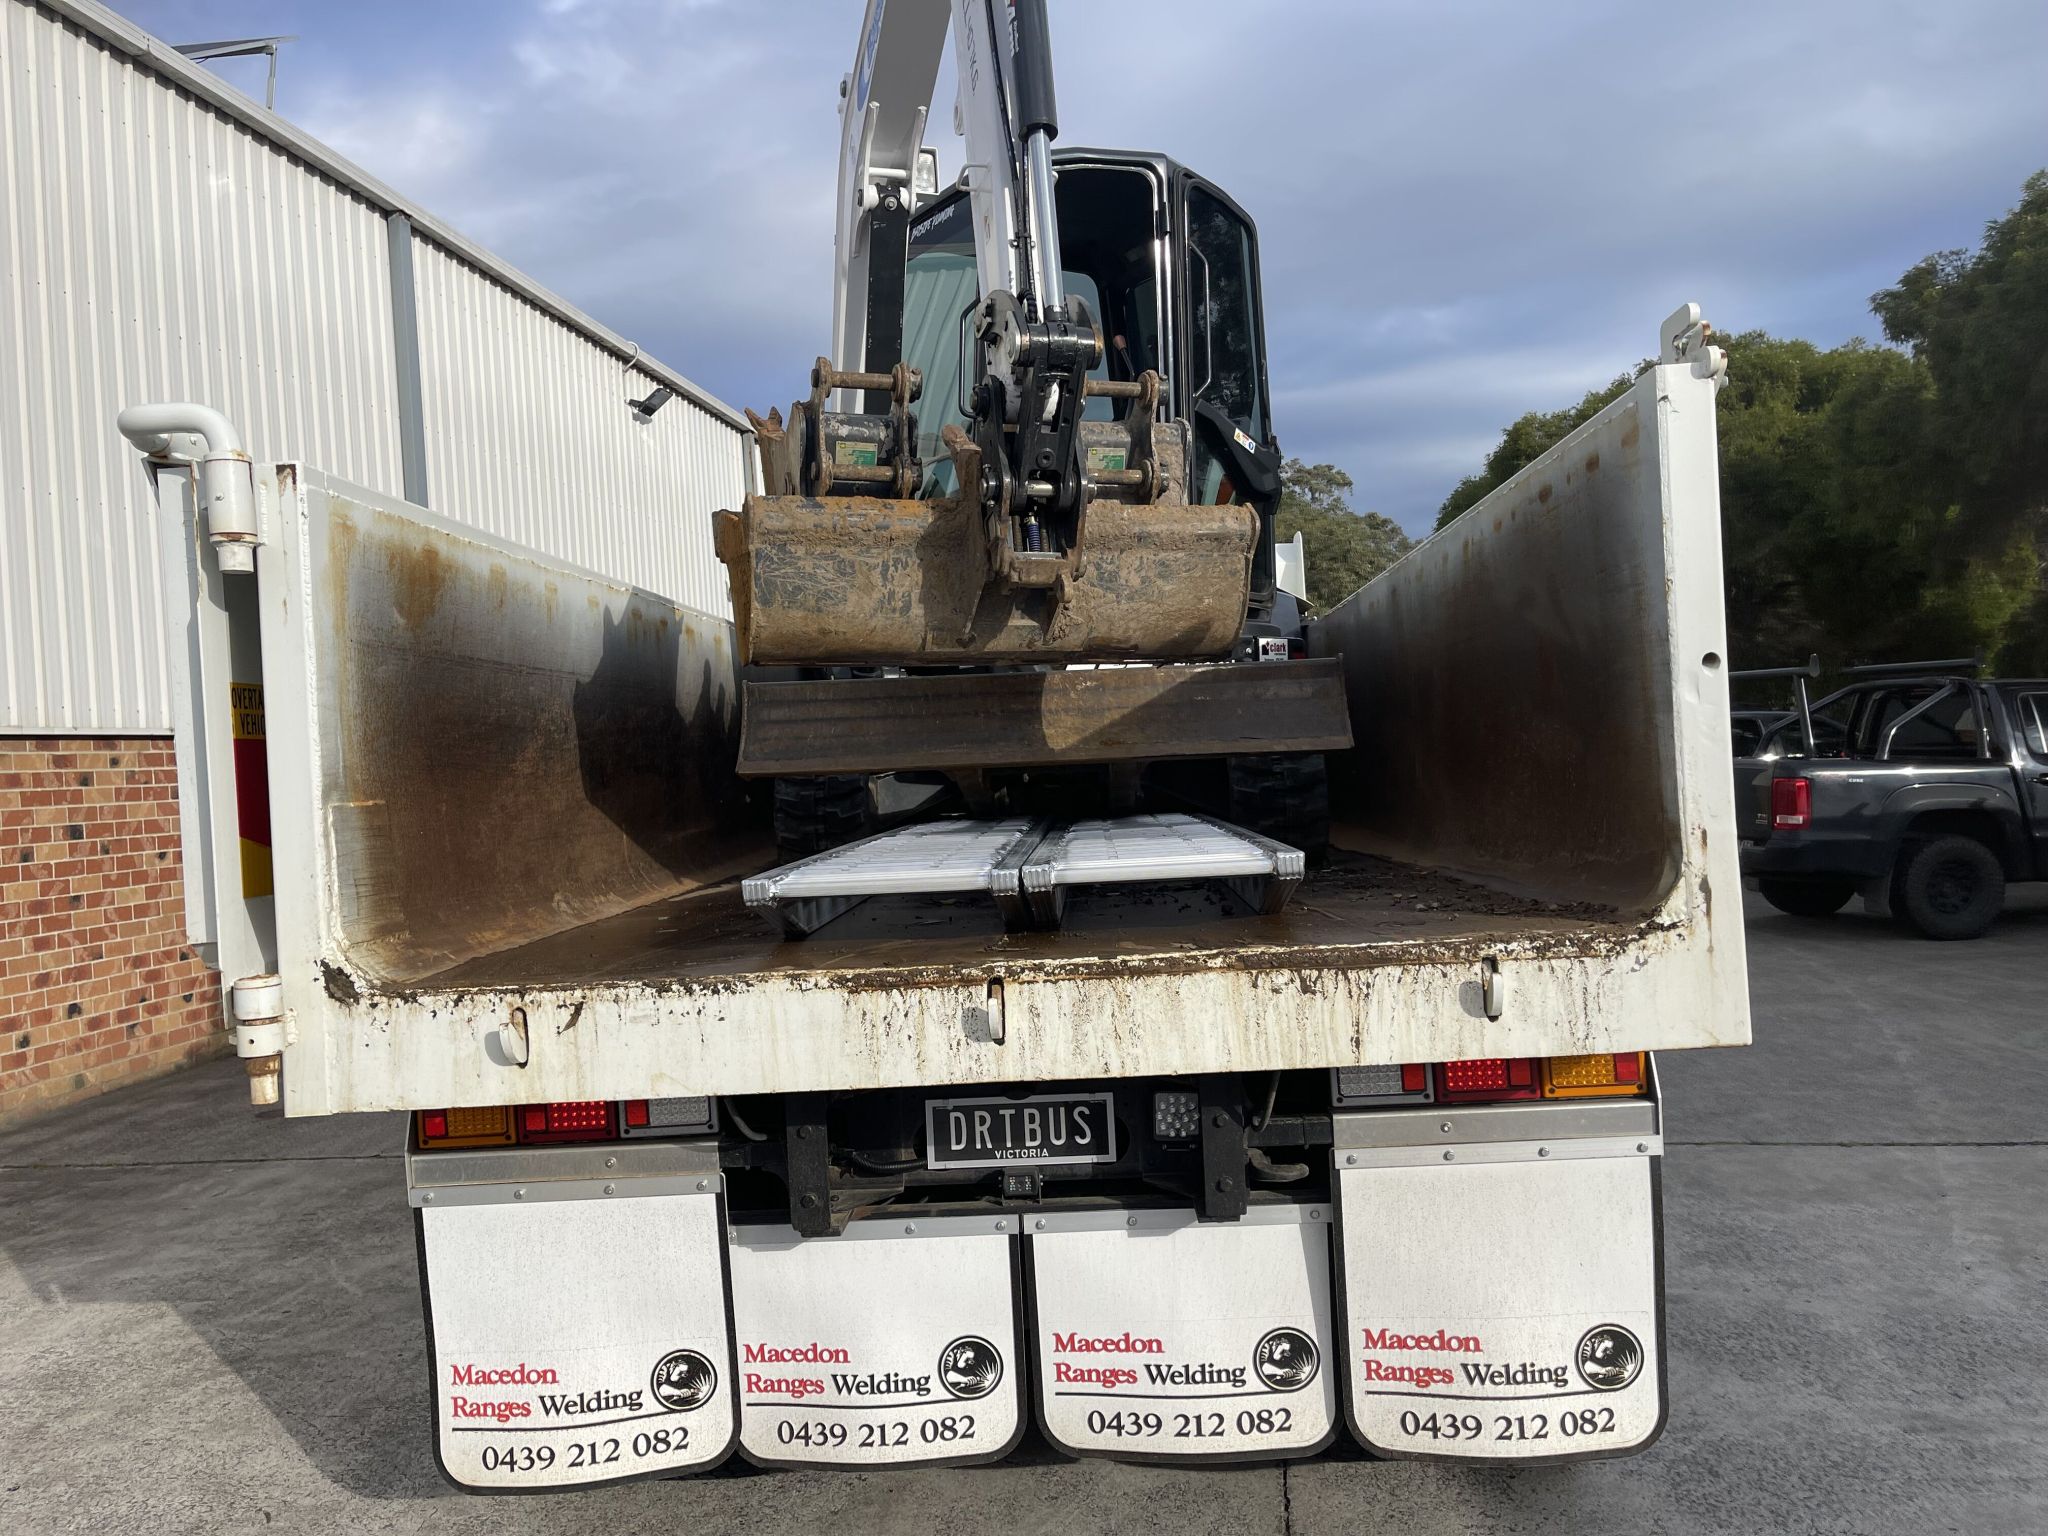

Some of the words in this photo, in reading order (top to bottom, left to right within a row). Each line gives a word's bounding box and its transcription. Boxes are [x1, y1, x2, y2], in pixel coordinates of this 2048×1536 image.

[1270, 643, 1286, 653] clark
[950, 1105, 1092, 1150] DRTBUS
[995, 1148, 1049, 1159] VICTORIA
[743, 1343, 850, 1364] Macedon
[1052, 1332, 1165, 1354] Macedon
[1362, 1328, 1483, 1352] Macedon
[451, 1363, 559, 1386] Macedon
[744, 1373, 825, 1399] Ranges
[831, 1372, 931, 1396] Welding
[1053, 1362, 1138, 1389] Ranges
[1143, 1363, 1246, 1387] Welding
[1363, 1360, 1454, 1388] Ranges
[1460, 1362, 1568, 1387] Welding
[451, 1396, 531, 1422] Ranges
[538, 1389, 643, 1417] Welding
[777, 1420, 848, 1447] 0439
[858, 1422, 909, 1447] 212
[920, 1415, 976, 1443] 082
[1087, 1410, 1162, 1437] 0439
[1173, 1413, 1225, 1438] 212
[1236, 1408, 1292, 1435] 082
[1400, 1411, 1482, 1440] 0439
[1494, 1414, 1549, 1441] 212
[1559, 1408, 1616, 1437] 082
[481, 1446, 556, 1473] 0439
[567, 1438, 620, 1468] 212
[632, 1426, 689, 1457] 082
